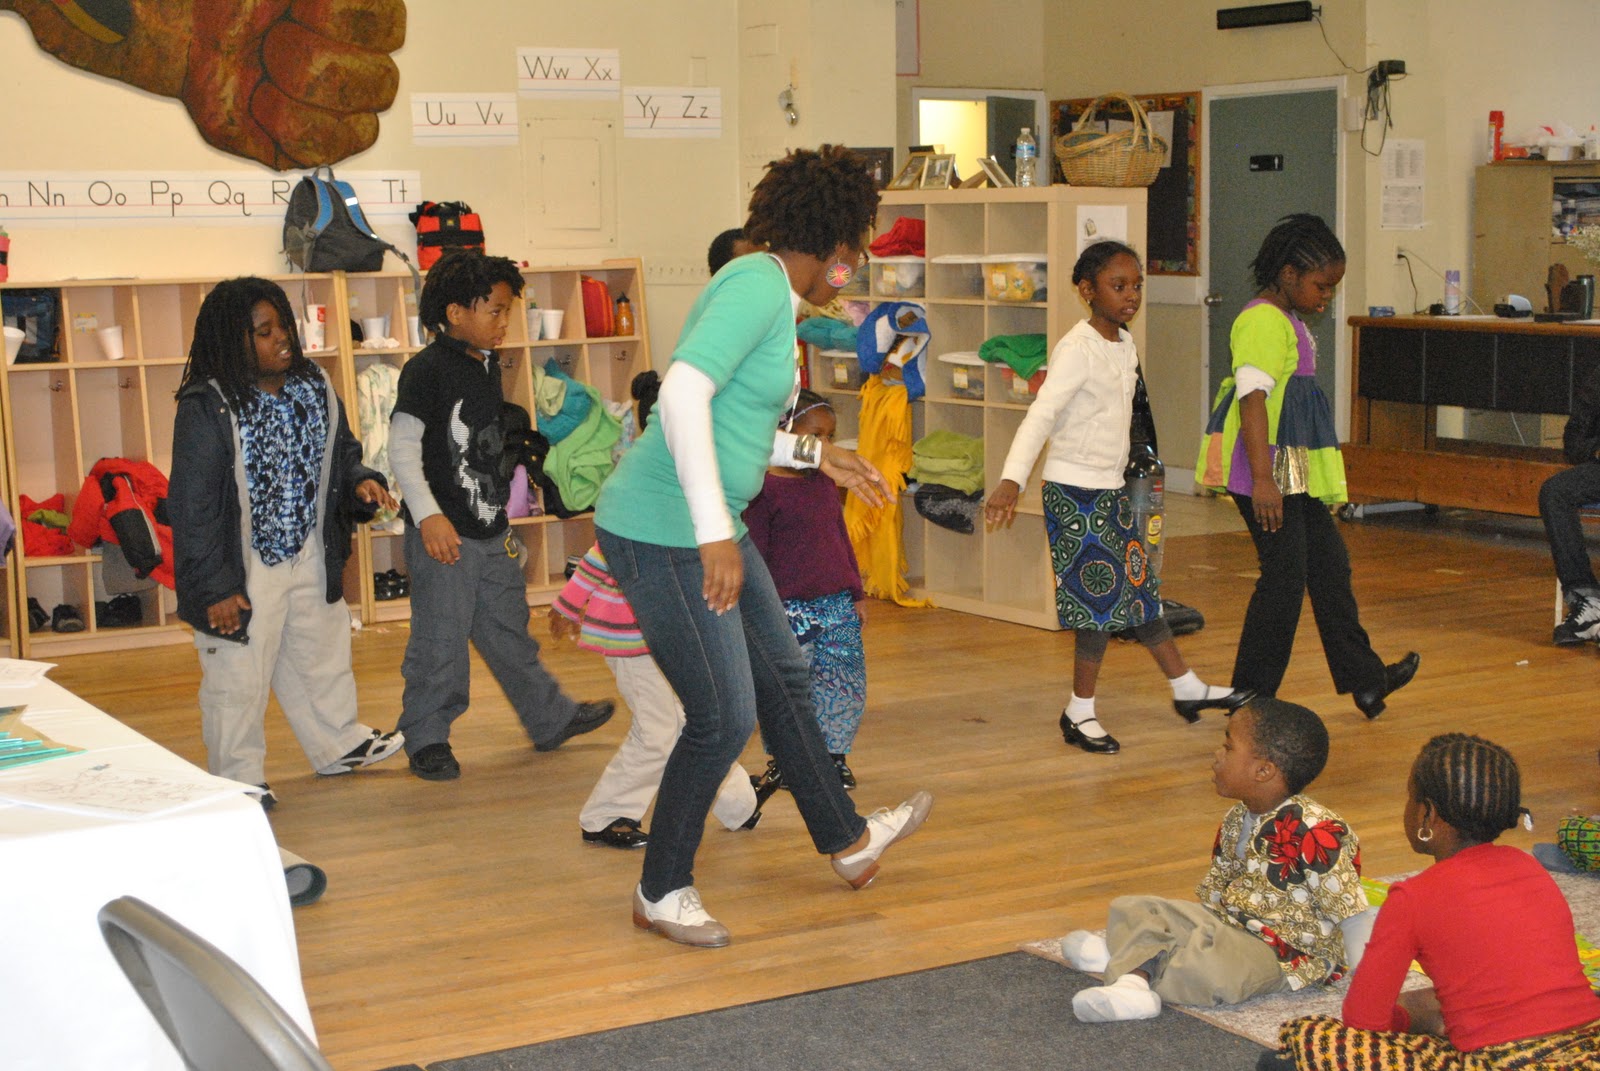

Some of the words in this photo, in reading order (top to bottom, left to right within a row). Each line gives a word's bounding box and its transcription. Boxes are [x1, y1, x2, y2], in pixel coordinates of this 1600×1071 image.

[522, 55, 570, 80] Ww
[584, 56, 613, 81] Xx
[425, 101, 457, 126] Uu
[475, 101, 504, 126] Vv
[635, 94, 660, 129] Yy
[681, 94, 710, 119] Zz
[28, 180, 65, 207] Nn
[87, 180, 127, 207] Oo
[149, 180, 184, 217] Pp
[207, 180, 252, 217] Qq
[381, 179, 408, 204] Tt
